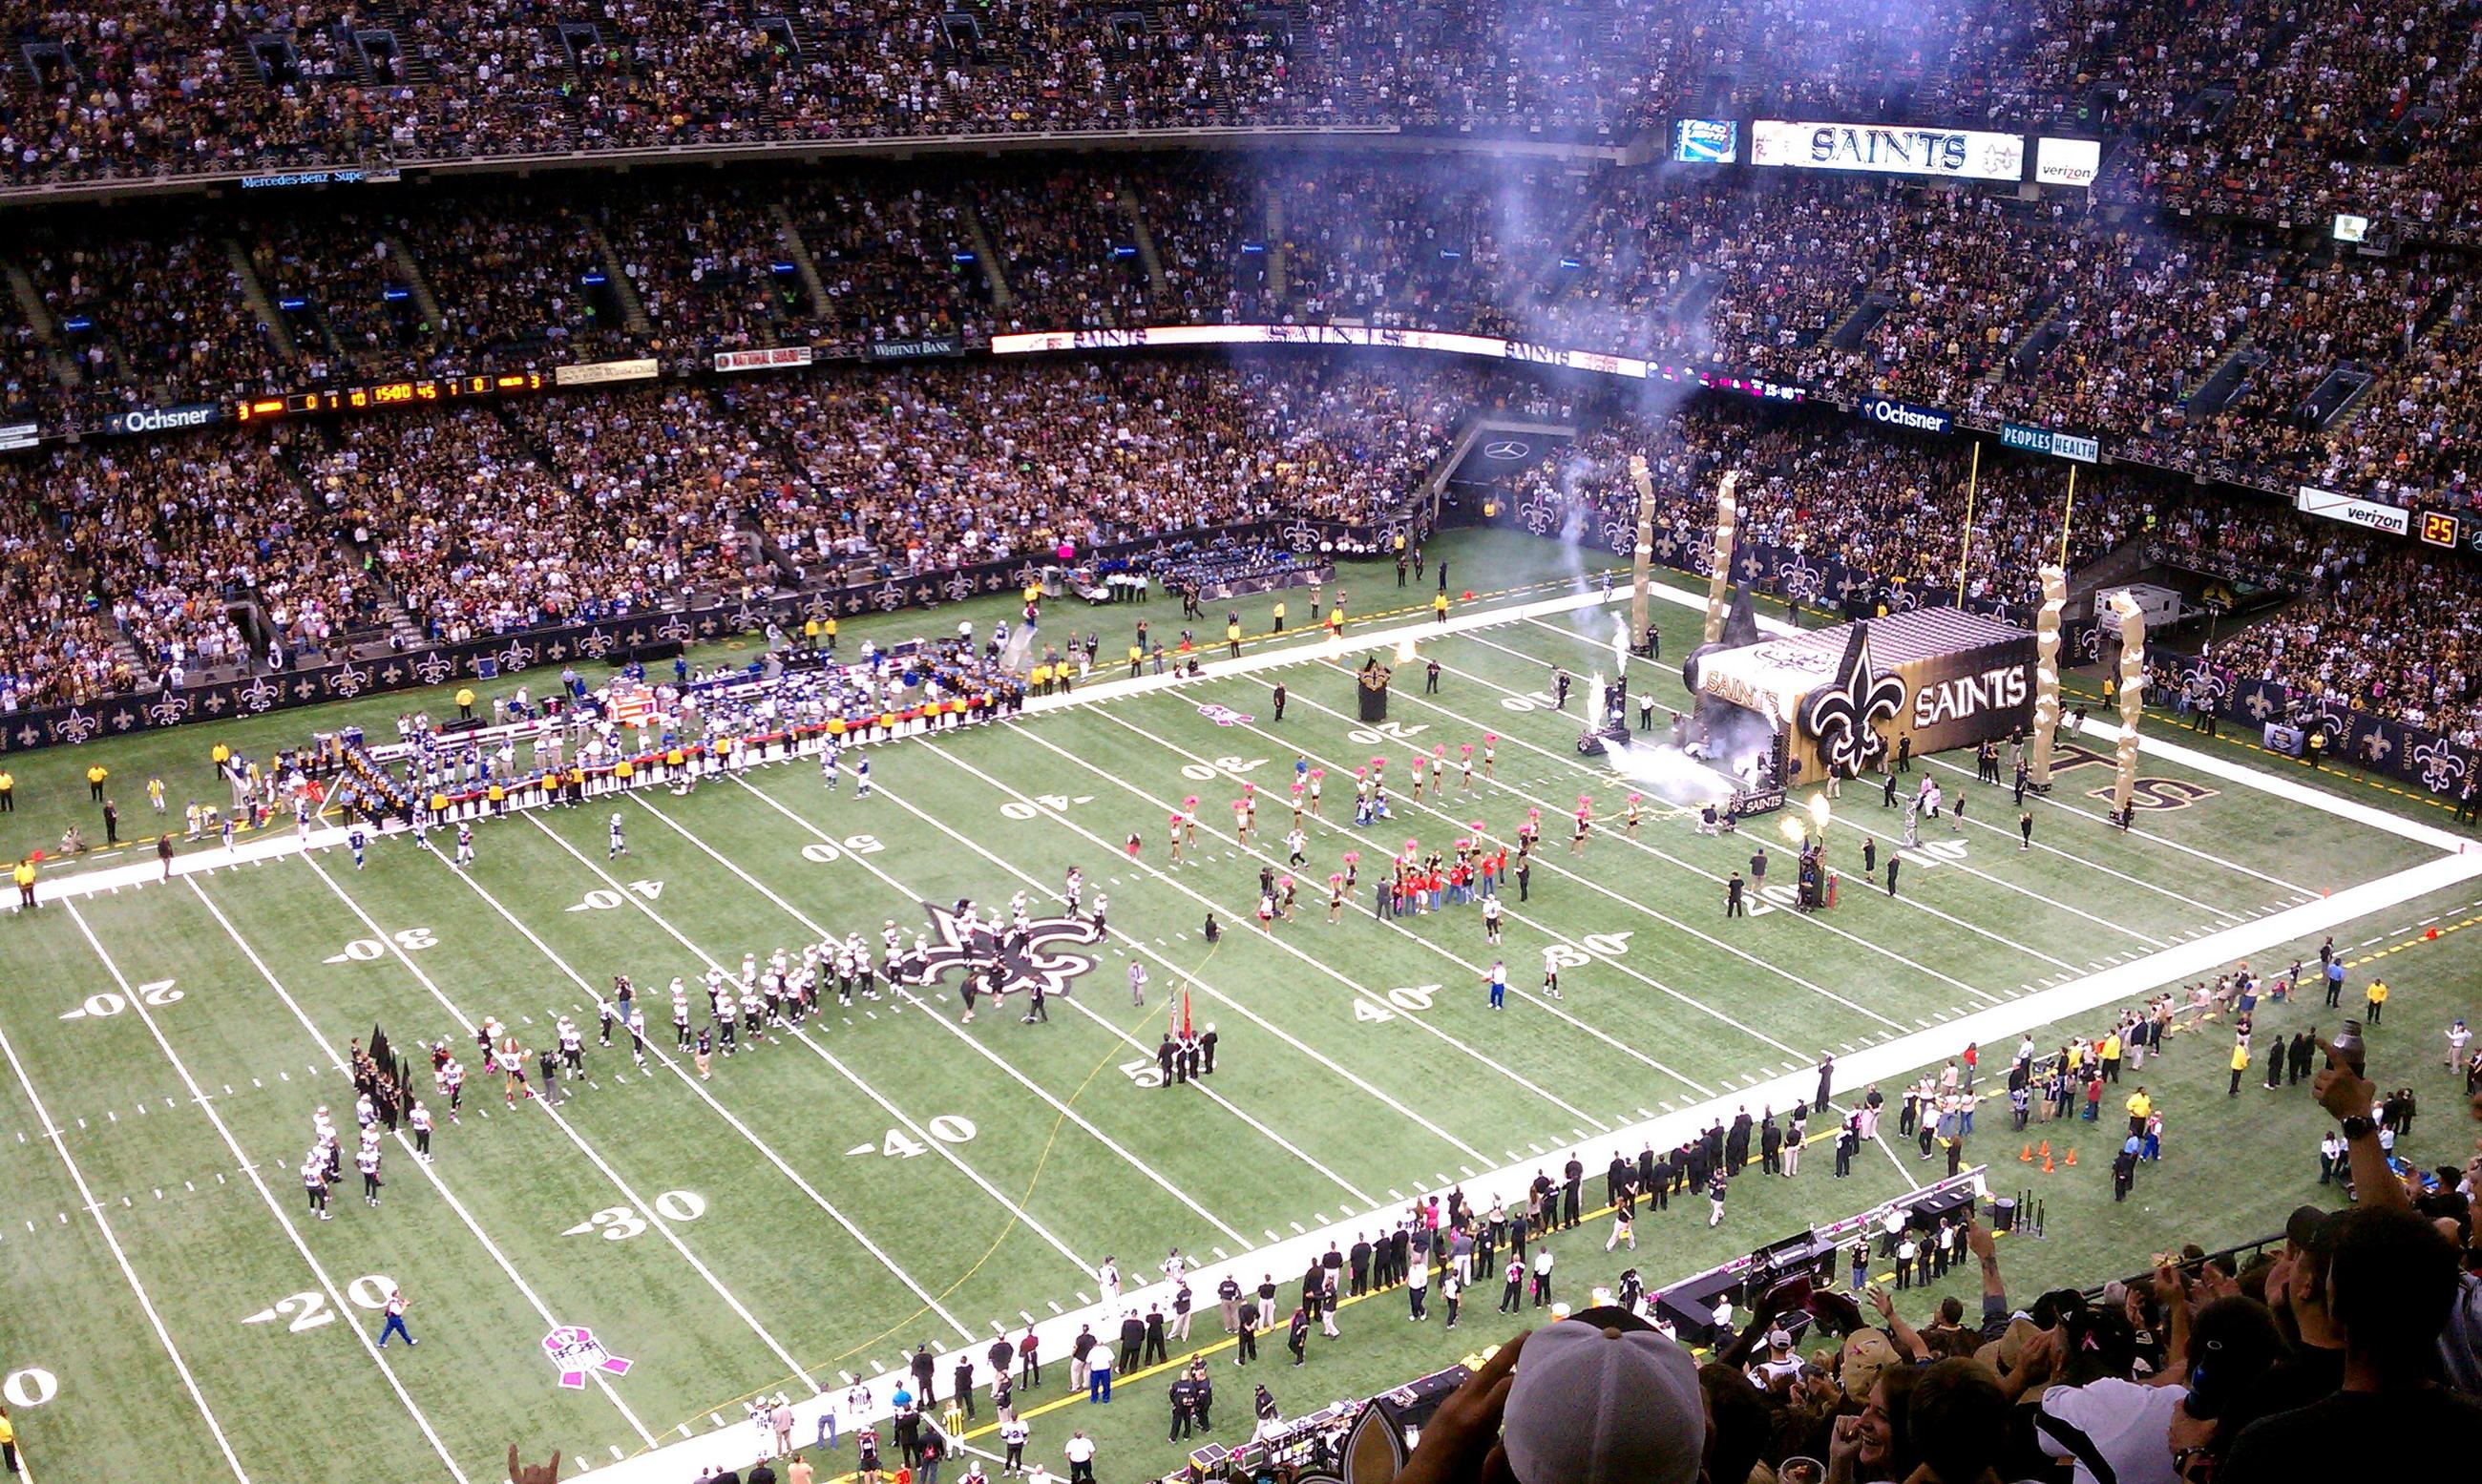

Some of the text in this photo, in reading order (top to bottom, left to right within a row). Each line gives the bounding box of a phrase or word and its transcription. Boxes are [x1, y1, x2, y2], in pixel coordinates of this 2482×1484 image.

[1811, 127, 1967, 172] SAINTS
[242, 173, 329, 189] Mercedes-Benz
[2042, 163, 2091, 180] verizon
[1267, 324, 1402, 347] SAINTS
[874, 342, 952, 356] WHITNEY BANK
[374, 384, 411, 401] 15:00
[416, 385, 436, 399] 45
[473, 378, 484, 392] 0
[350, 392, 367, 407] 10
[126, 408, 209, 432] Ochsner
[1876, 400, 1944, 431] Ochsner
[2004, 426, 2096, 460] PEOPLES HEALTH
[2347, 506, 2404, 532] verizon
[2426, 516, 2452, 542] 25
[1706, 670, 1779, 714] SAINTS
[1913, 664, 2028, 730] SAINTS
[1746, 795, 1782, 813] SAINTS
[1353, 987, 1433, 1023] 40
[883, 1115, 978, 1160] 40
[591, 1190, 706, 1241] 30
[275, 1274, 399, 1332] 20
